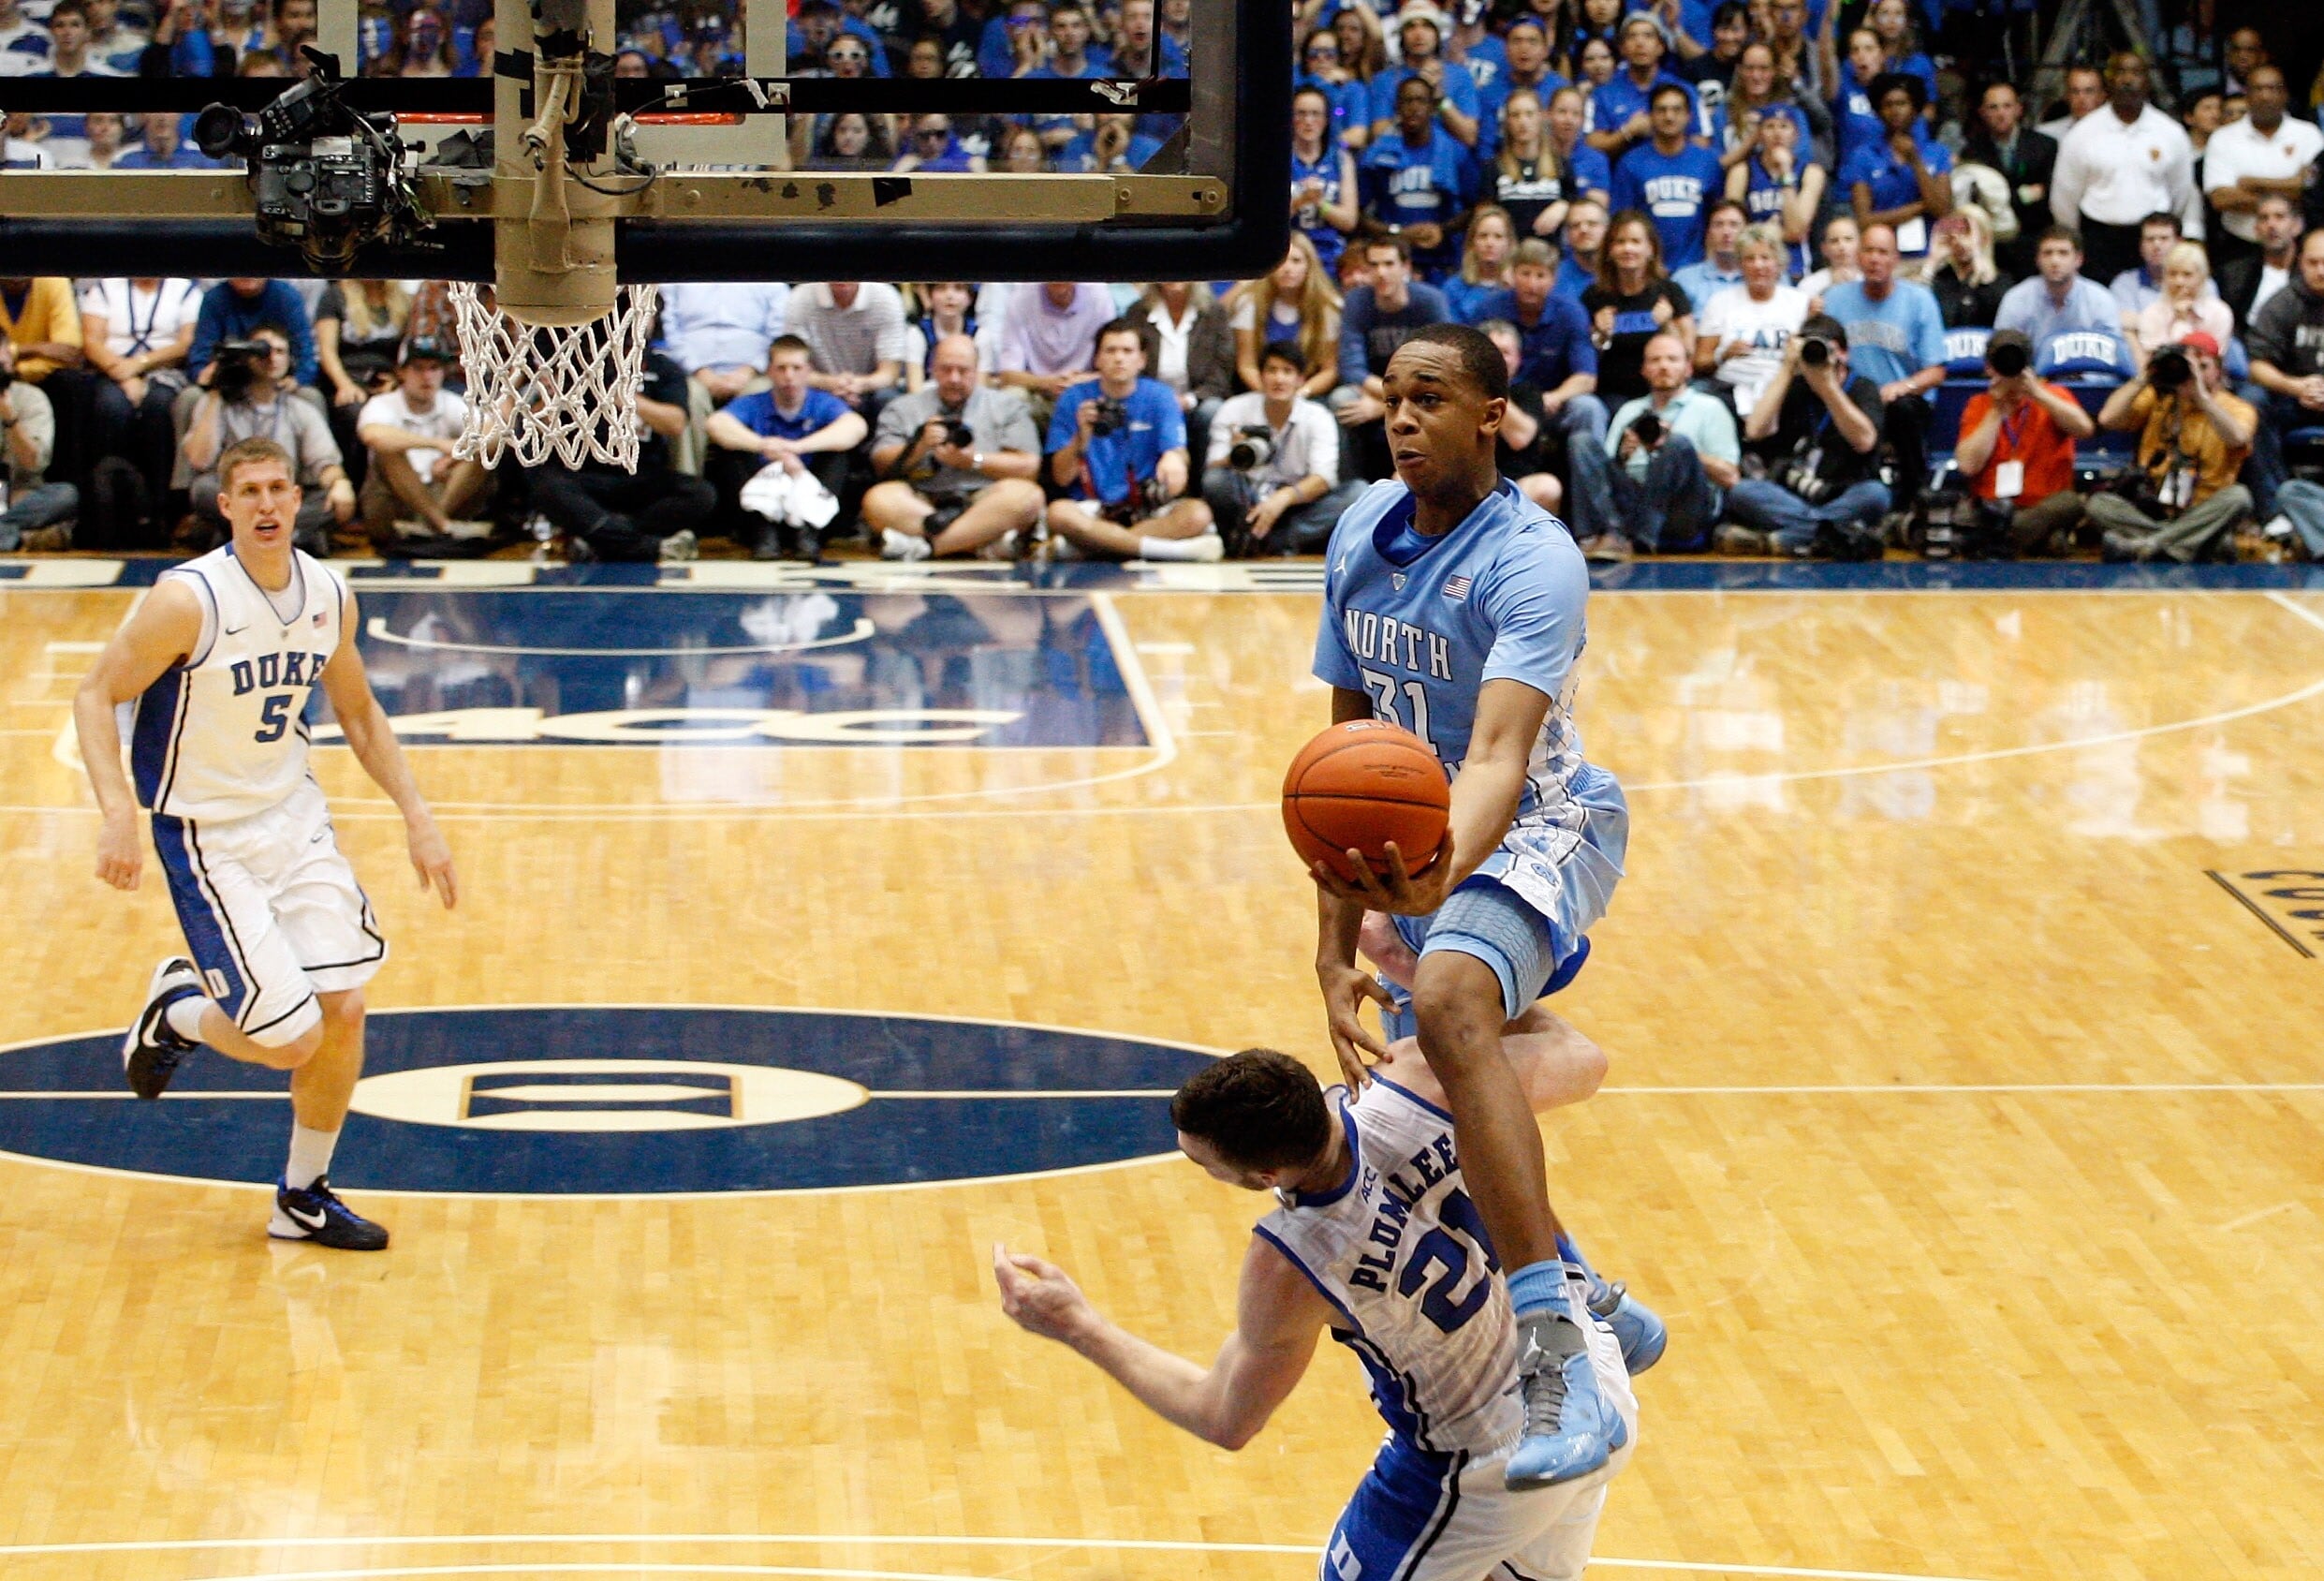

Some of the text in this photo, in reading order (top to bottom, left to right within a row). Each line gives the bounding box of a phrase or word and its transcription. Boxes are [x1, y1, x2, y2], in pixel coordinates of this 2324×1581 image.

[1645, 175, 1702, 203] DUKE
[2052, 332, 2117, 365] DUKE
[230, 651, 327, 696] DUKE
[1346, 609, 1452, 682] NORTH
[255, 694, 293, 743] 5
[1361, 666, 1440, 757] 31
[1349, 1132, 1461, 1293] PLUMLEE
[1398, 1186, 1503, 1335] 21
